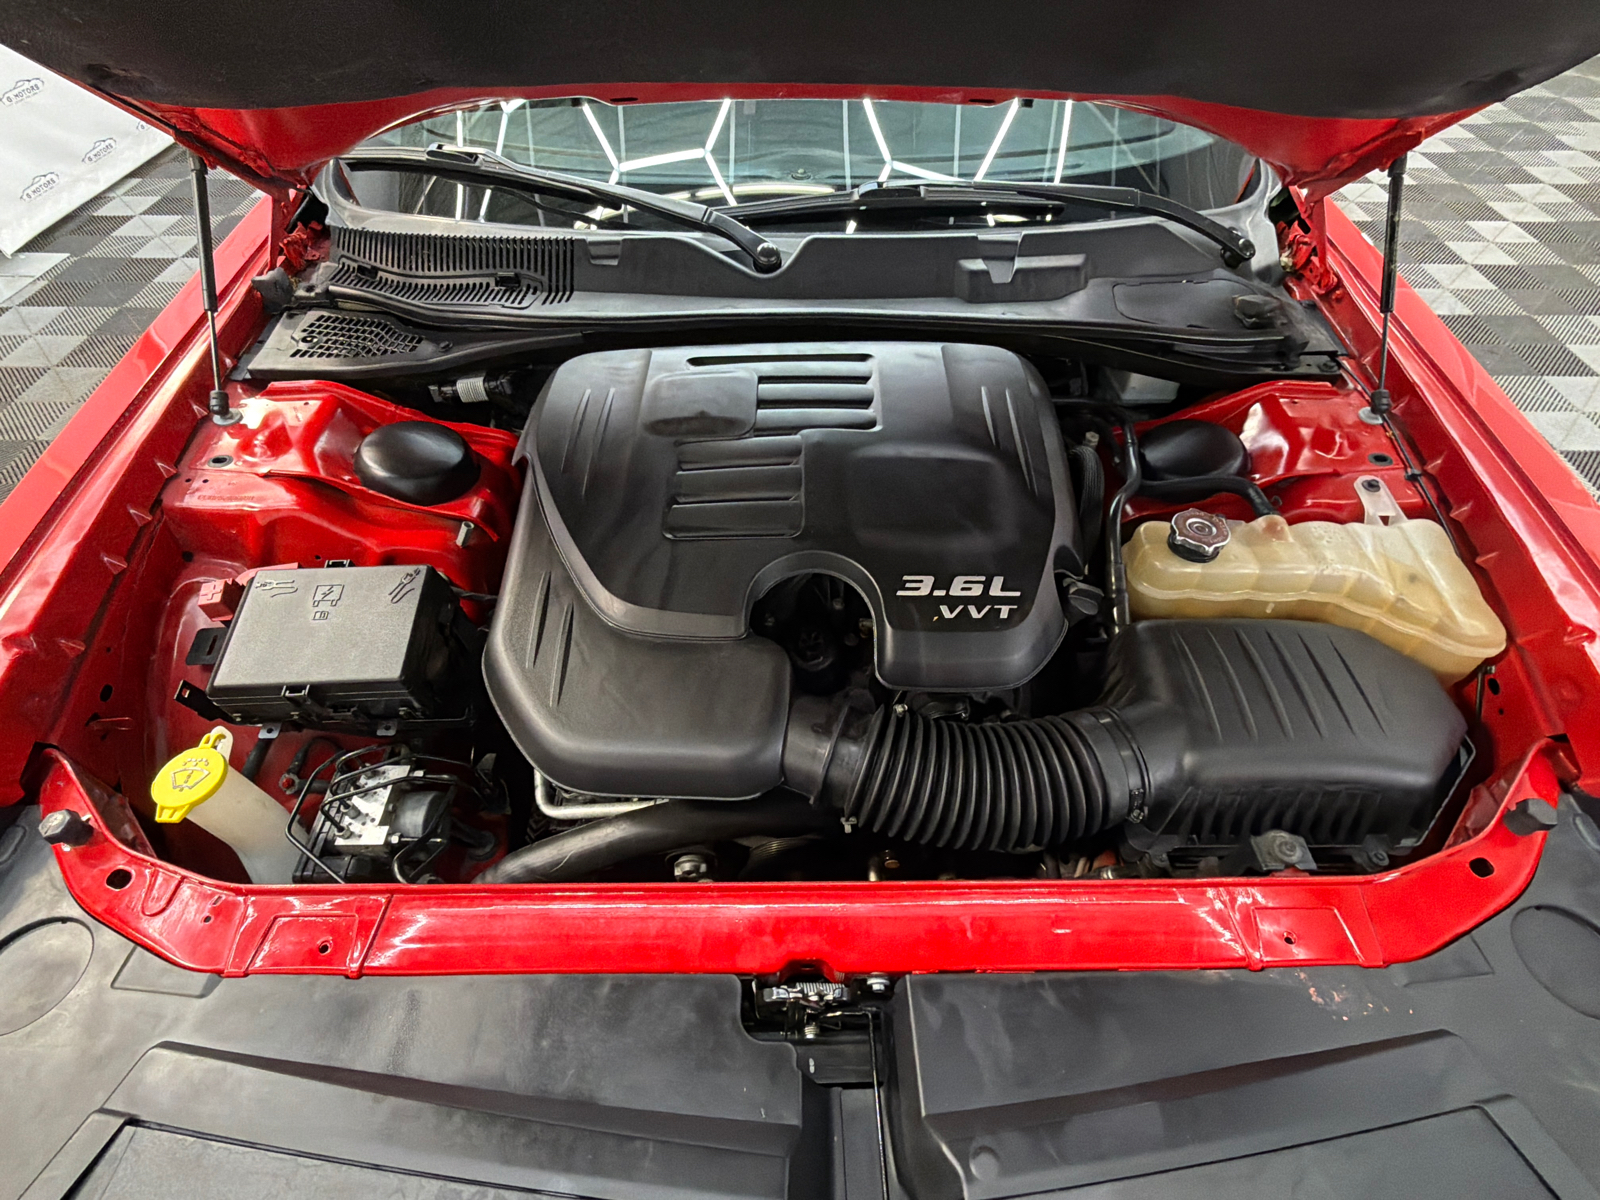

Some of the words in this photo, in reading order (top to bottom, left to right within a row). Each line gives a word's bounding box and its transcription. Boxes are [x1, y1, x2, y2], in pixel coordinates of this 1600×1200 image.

[13, 83, 40, 99] MOTORS
[31, 177, 56, 195] MOTORS
[896, 575, 1021, 597] 3.6L
[939, 605, 1018, 619] VVT
